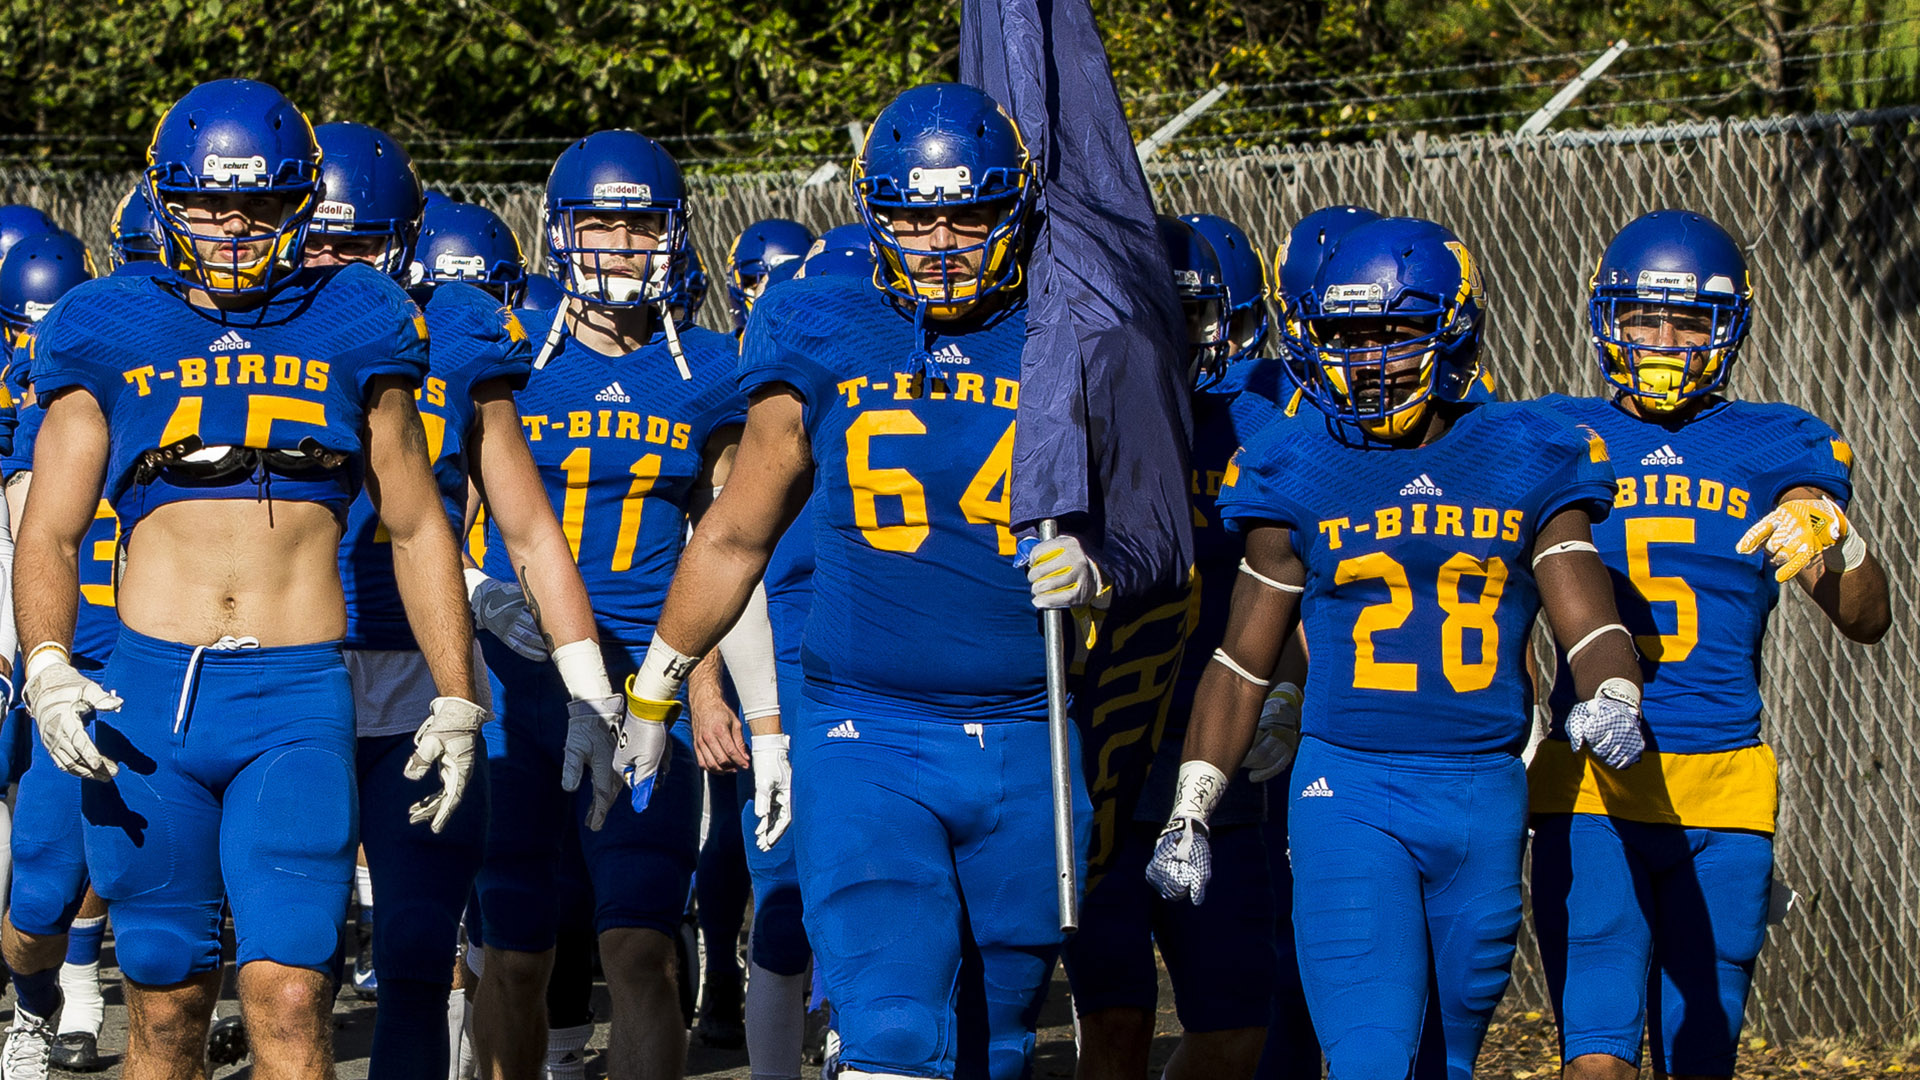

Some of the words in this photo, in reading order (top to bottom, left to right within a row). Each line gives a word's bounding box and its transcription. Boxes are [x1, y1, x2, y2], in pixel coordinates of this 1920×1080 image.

[223, 162, 249, 170] schutt
[606, 185, 638, 194] Riddell
[1655, 276, 1680, 285] schutt
[208, 341, 251, 353] adidas
[122, 354, 330, 397] T-BIRDS
[595, 393, 631, 404] adidas
[521, 410, 692, 450] T-BIRDS
[1641, 456, 1684, 466] adidas
[845, 409, 1018, 556] 64
[1399, 486, 1443, 497] adidas
[560, 447, 662, 572] 11
[1318, 503, 1524, 551] T-BIRDS
[1625, 517, 1699, 663] 5
[1333, 551, 1509, 694] 28
[827, 730, 860, 739] adidas
[1301, 789, 1334, 798] adidas
